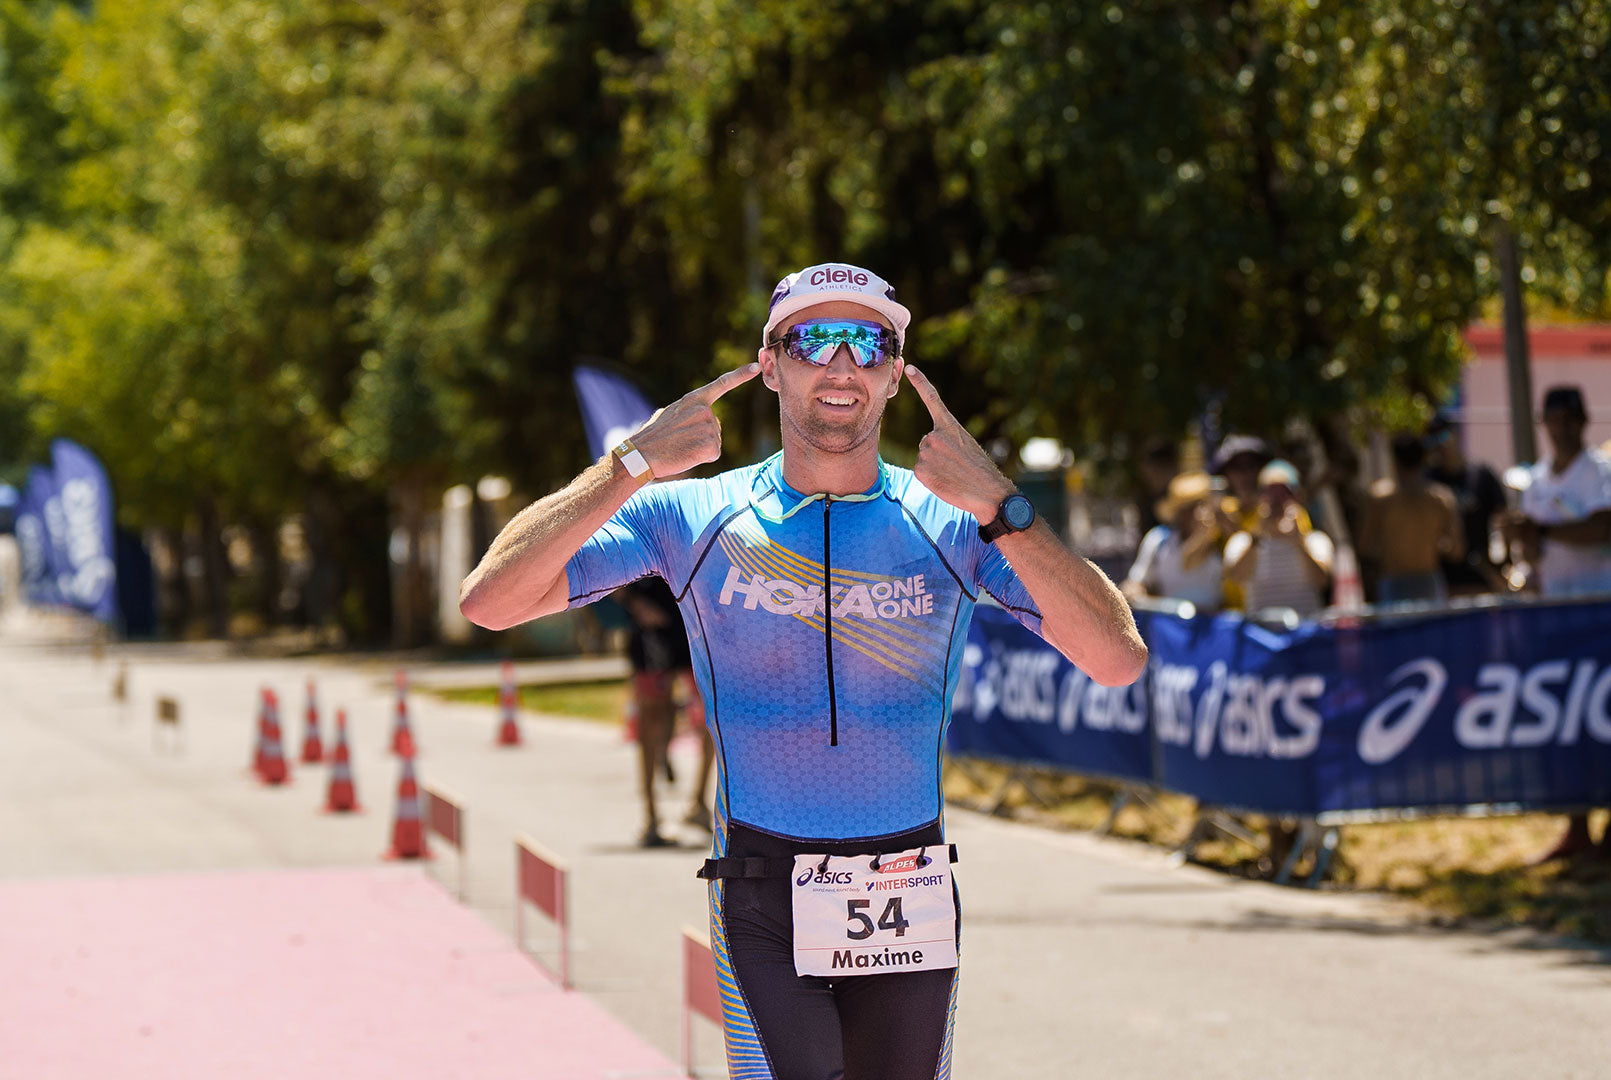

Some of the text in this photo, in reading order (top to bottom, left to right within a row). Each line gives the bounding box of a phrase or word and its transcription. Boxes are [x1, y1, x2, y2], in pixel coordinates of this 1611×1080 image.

[719, 566, 926, 619] HOKA ONE
[877, 593, 933, 619] ONE
[883, 860, 915, 872] ALPES
[875, 875, 944, 891] INTERSPORT
[847, 897, 909, 940] 54
[831, 947, 923, 969] Maxime
